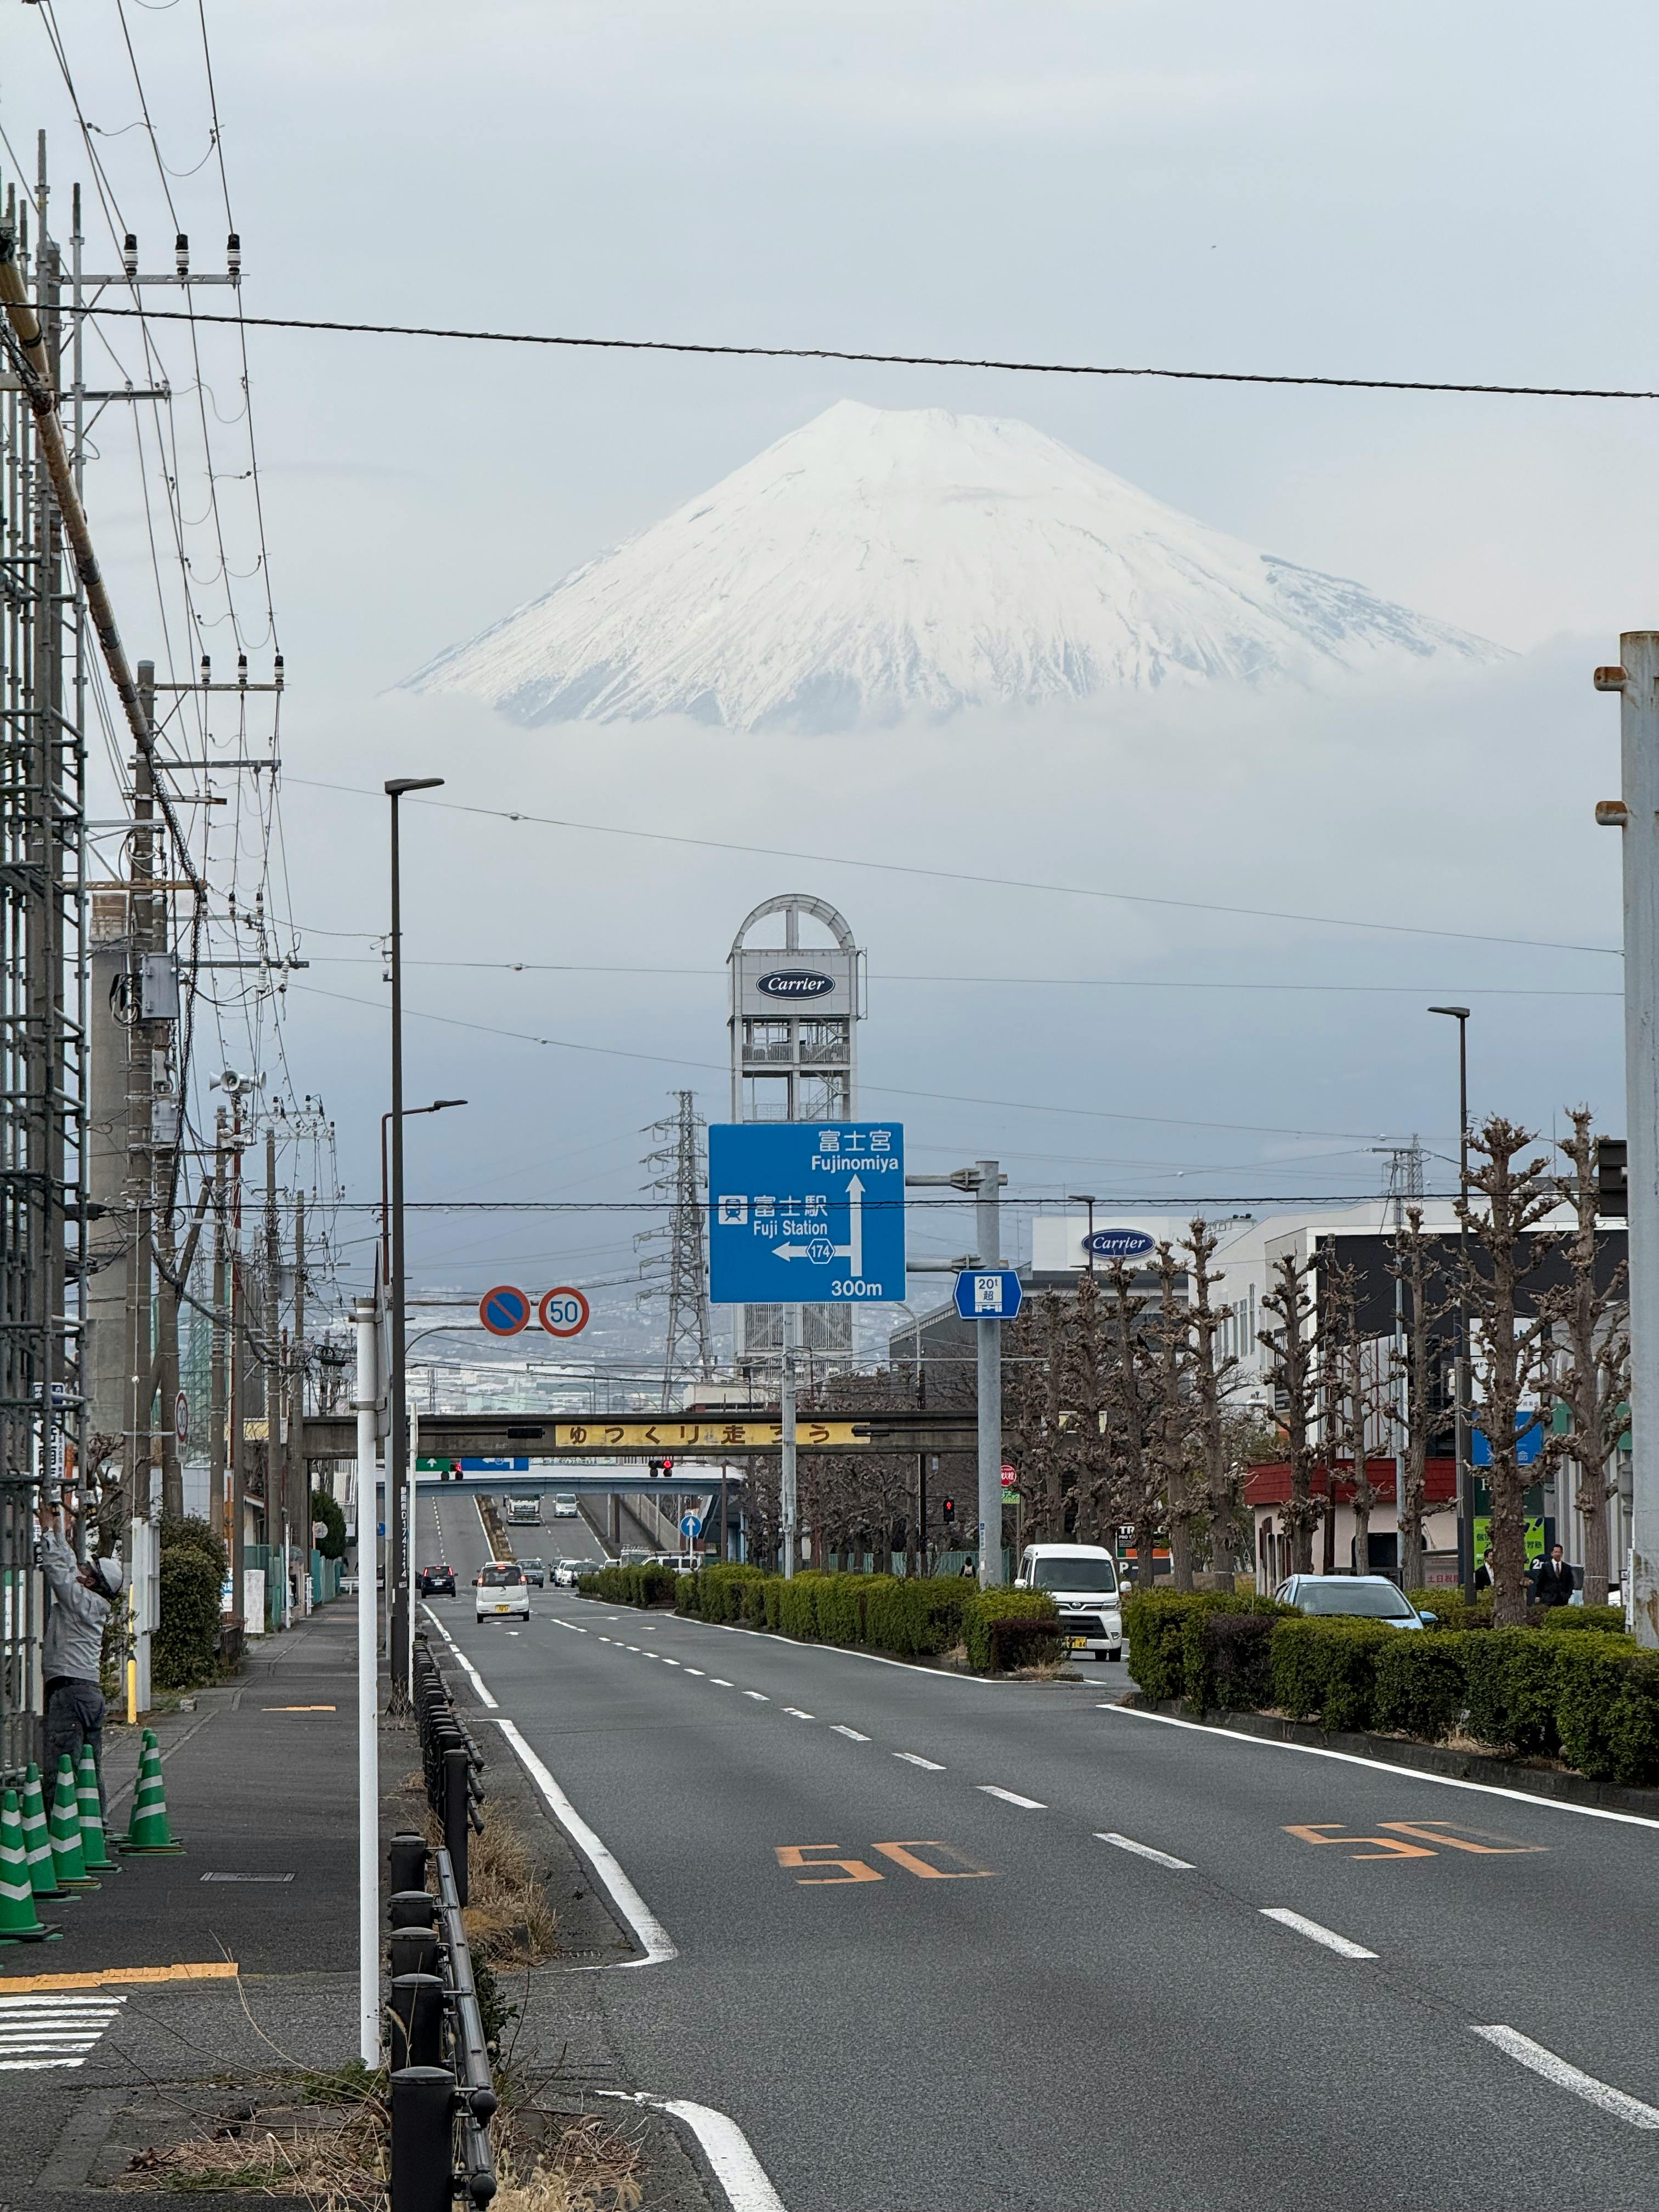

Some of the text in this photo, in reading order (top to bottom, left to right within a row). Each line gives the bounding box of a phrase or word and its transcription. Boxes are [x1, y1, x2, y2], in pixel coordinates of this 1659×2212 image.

[768, 977, 825, 990] Carrier
[818, 1130, 891, 1152] 富士宮
[811, 1155, 898, 1173] Fujinomiya
[753, 1195, 827, 1216] 富士駅
[754, 1220, 827, 1238] Fuji Station
[811, 1245, 830, 1257] 174
[1092, 1237, 1146, 1249] Carrier
[831, 1280, 882, 1296] 300m
[983, 1290, 994, 1300] 超
[550, 1301, 578, 1323] 50
